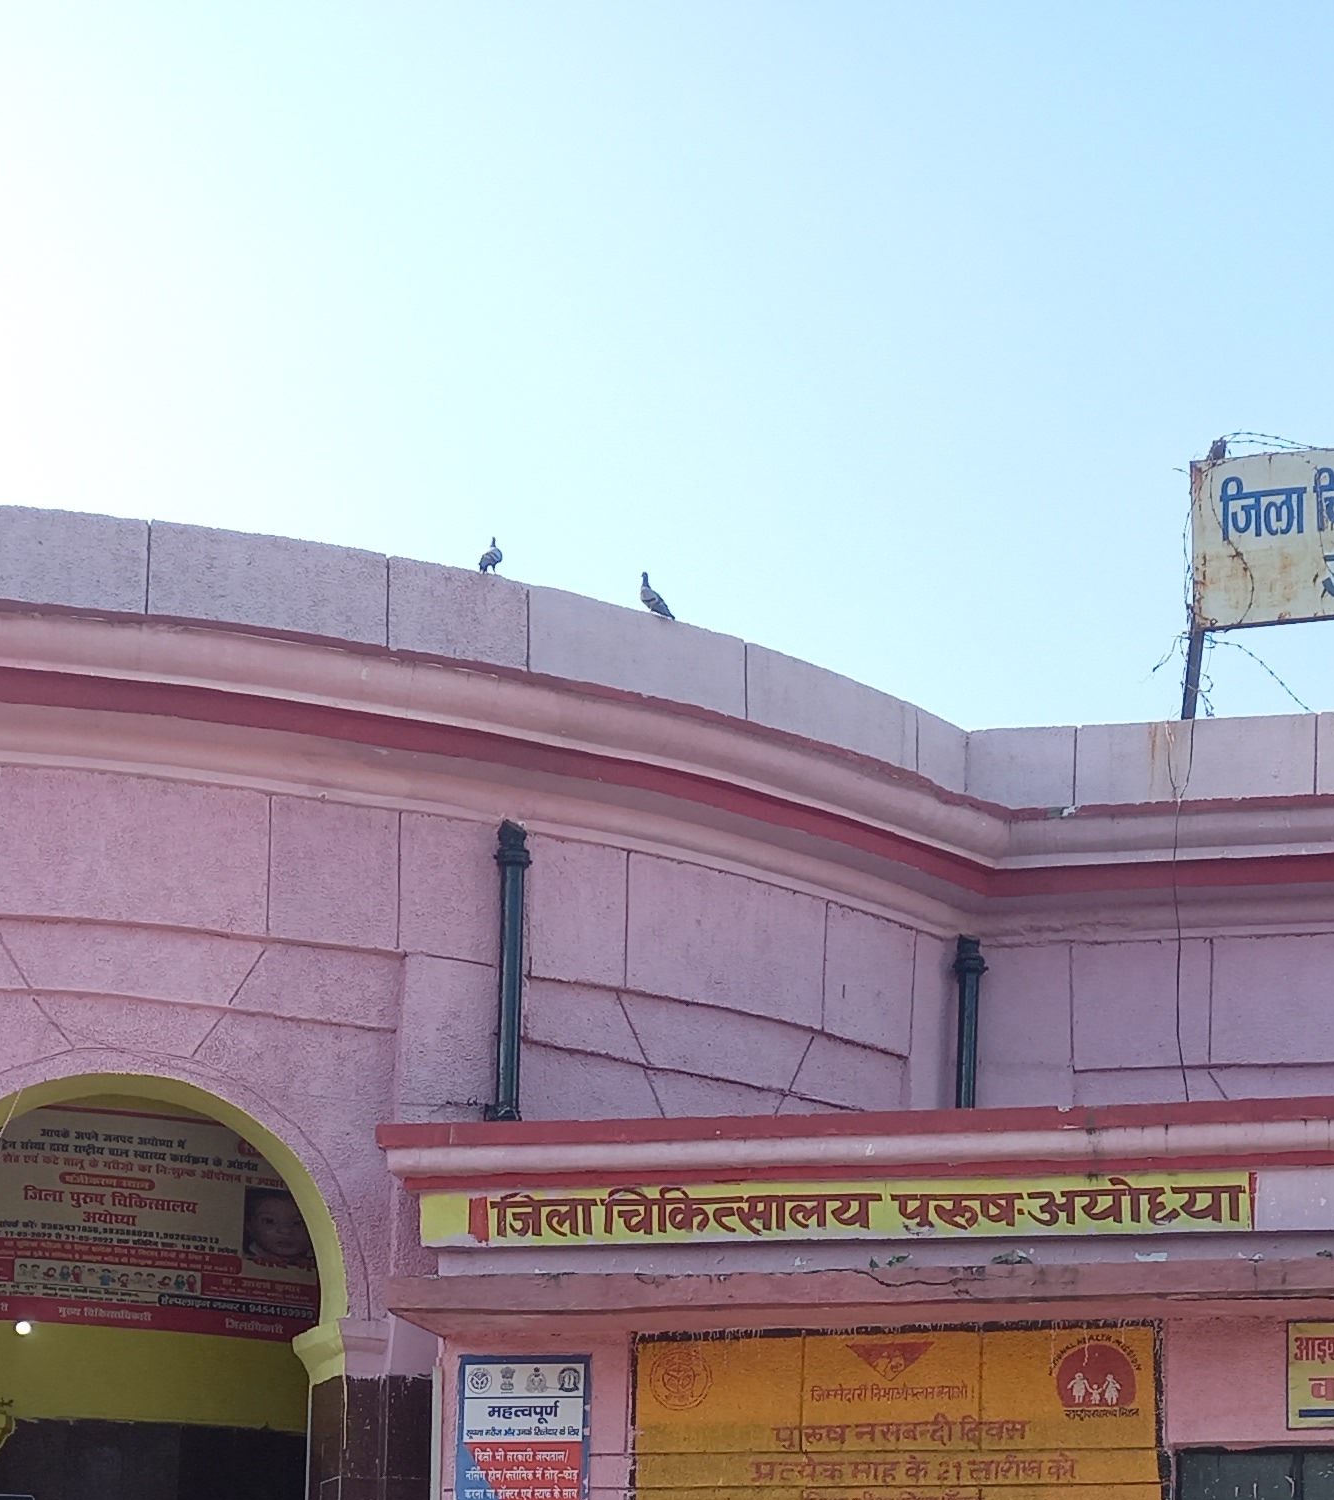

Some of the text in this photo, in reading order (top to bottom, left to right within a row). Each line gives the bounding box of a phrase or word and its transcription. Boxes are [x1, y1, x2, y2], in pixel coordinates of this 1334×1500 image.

[1221, 476, 1307, 540] जिला
[104, 1133, 133, 1144] जनपद
[24, 1184, 64, 1202] जिला
[112, 1191, 198, 1214] चिकित्सालय
[83, 1209, 137, 1227] अयोध्या
[490, 1191, 597, 1237] जिला
[601, 1185, 883, 1237] चिकित्सालय
[811, 1383, 868, 1403] जिम्मेदारी
[487, 1399, 560, 1425] महत्वपूर्ण
[503, 1427, 515, 1437] और
[854, 1412, 954, 1446] नसबन्दी
[959, 1416, 1031, 1446] दिवस
[474, 1448, 492, 1463] किसी
[495, 1448, 504, 1461] भी
[507, 1448, 533, 1462] सरकारी
[752, 1455, 845, 1483] प्रत्येक
[848, 1460, 901, 1486] माह
[904, 1454, 927, 1480] के
[1048, 1451, 1079, 1479] को
[465, 1488, 483, 1500] करना
[497, 1485, 519, 1500] डॉक्टर
[521, 1486, 532, 1500] एवं
[554, 1485, 560, 1499] के
